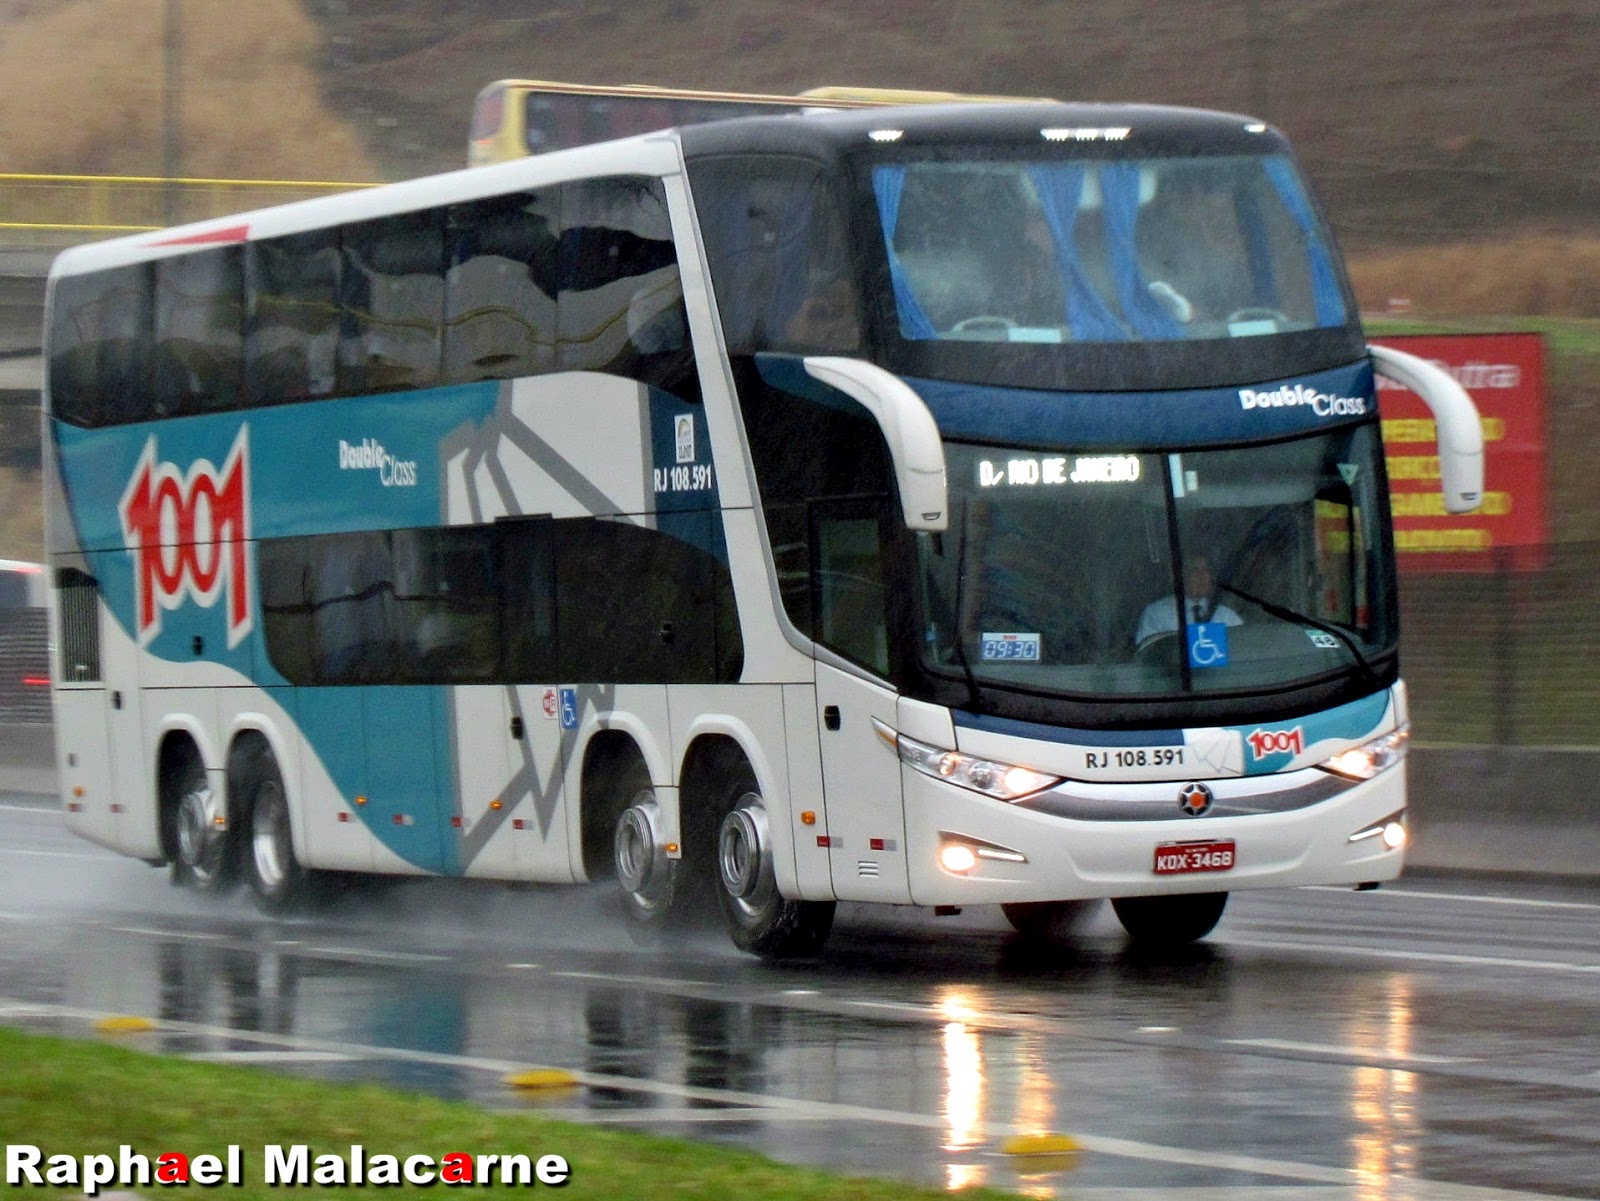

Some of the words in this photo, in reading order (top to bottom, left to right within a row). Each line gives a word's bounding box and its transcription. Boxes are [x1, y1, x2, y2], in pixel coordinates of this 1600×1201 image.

[1238, 384, 1318, 410] Double
[1312, 393, 1366, 416] Class
[339, 438, 385, 469] Double
[380, 454, 416, 487] Class
[1042, 457, 1067, 484] DE
[654, 467, 668, 492] RJ
[670, 464, 712, 491] 108.591
[120, 426, 252, 646] 1001
[984, 641, 1036, 658] 09:30
[1248, 727, 1303, 759] 1001
[1086, 752, 1108, 768] RJ
[1115, 749, 1184, 767] 108.591
